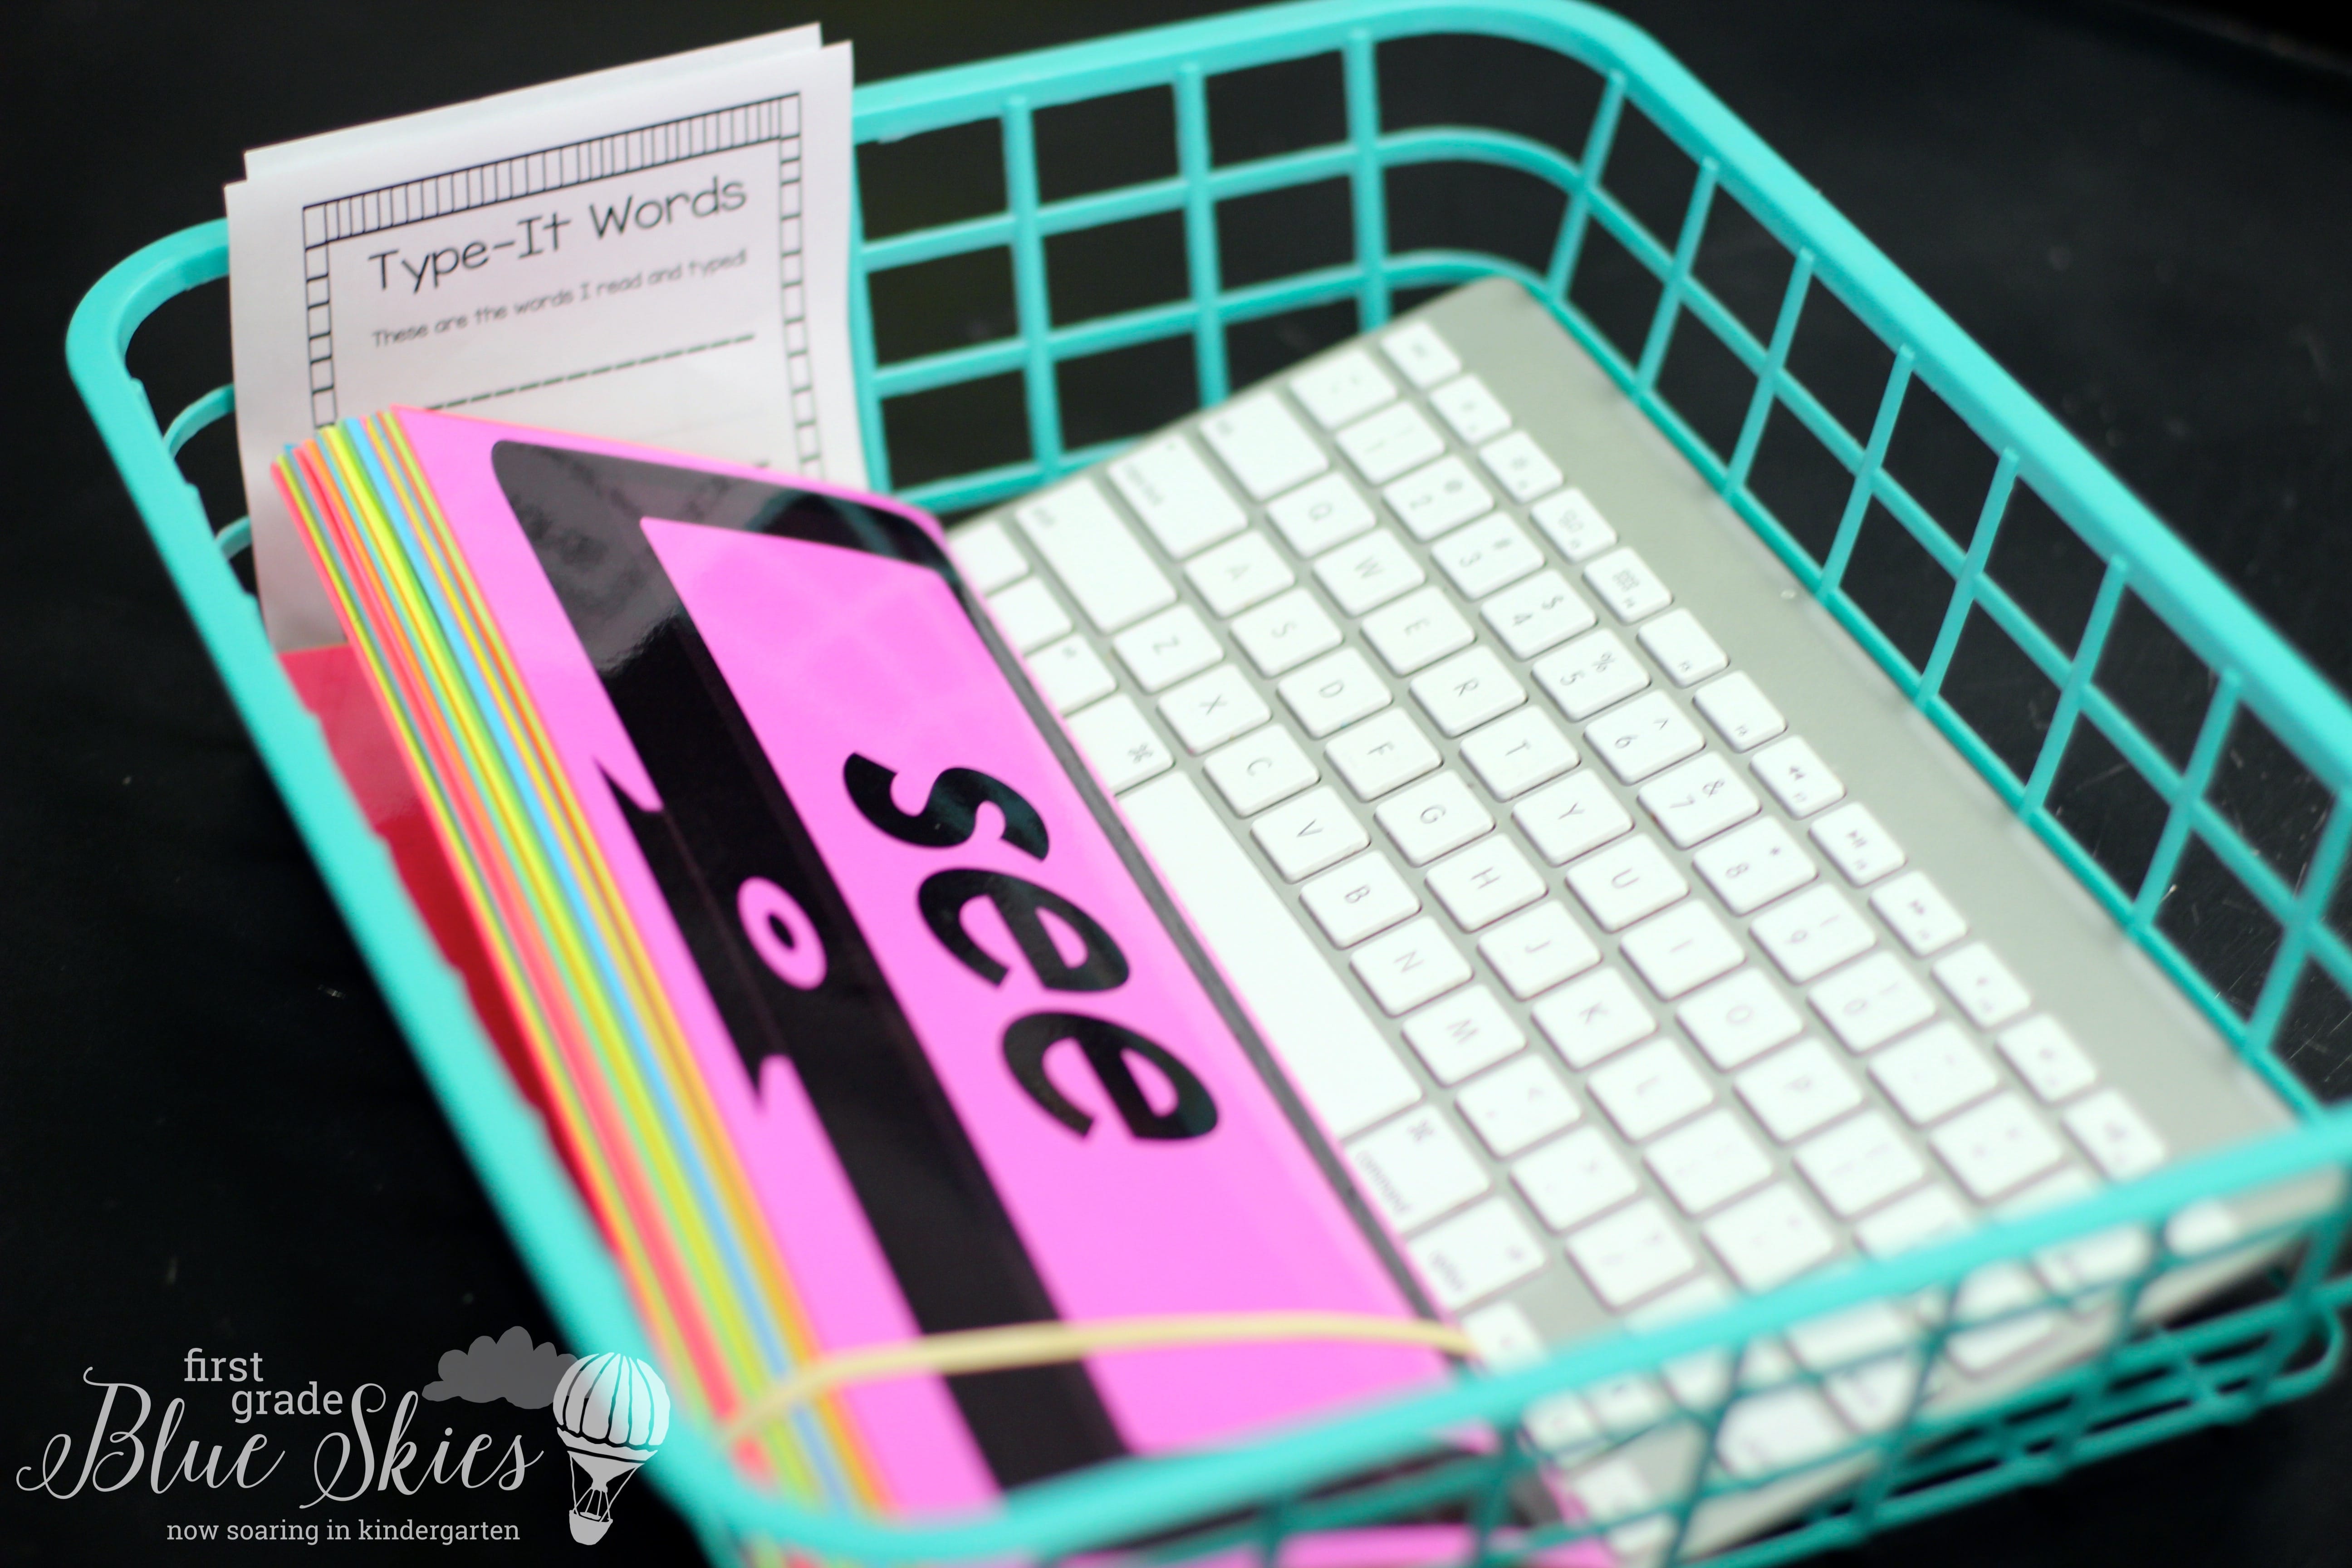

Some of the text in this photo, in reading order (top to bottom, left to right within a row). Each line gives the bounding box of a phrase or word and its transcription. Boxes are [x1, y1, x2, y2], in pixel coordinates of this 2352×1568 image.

[368, 175, 749, 293] Type-It Words
[371, 324, 428, 348] These
[435, 311, 468, 331] are
[474, 302, 508, 327] the
[513, 286, 574, 313] words
[579, 281, 593, 302] I
[596, 270, 642, 295] read
[647, 261, 684, 285] and
[1409, 494, 1433, 510] 2
[1308, 502, 1333, 522] Q
[1354, 557, 1383, 579] W
[1459, 552, 1482, 567] 3
[1226, 564, 1250, 581] A
[1404, 618, 1429, 635] E
[1514, 613, 1533, 626] 4
[1271, 622, 1296, 638] S
[1152, 636, 1180, 654] Z
[1593, 652, 1615, 672] %
[1560, 671, 1584, 685] 5
[1318, 680, 1345, 698] D
[1455, 679, 1479, 696] R
[1199, 695, 1227, 715] X
[1368, 742, 1393, 755] F
[1506, 740, 1530, 756] T
[1615, 735, 1636, 748] 6
[1247, 758, 1272, 775] C
[1420, 806, 1446, 823] G
[1559, 803, 1583, 819] Y
[1297, 820, 1322, 837] V
[1471, 867, 1500, 889] H
[1611, 868, 1639, 889] U
[1725, 863, 1749, 878] 8
[1344, 885, 1370, 903] B
[843, 752, 1219, 1142] see
[1524, 940, 1551, 954] J
[1394, 950, 1423, 973] N
[1579, 1002, 1609, 1024] K
[1447, 1019, 1479, 1044] M
